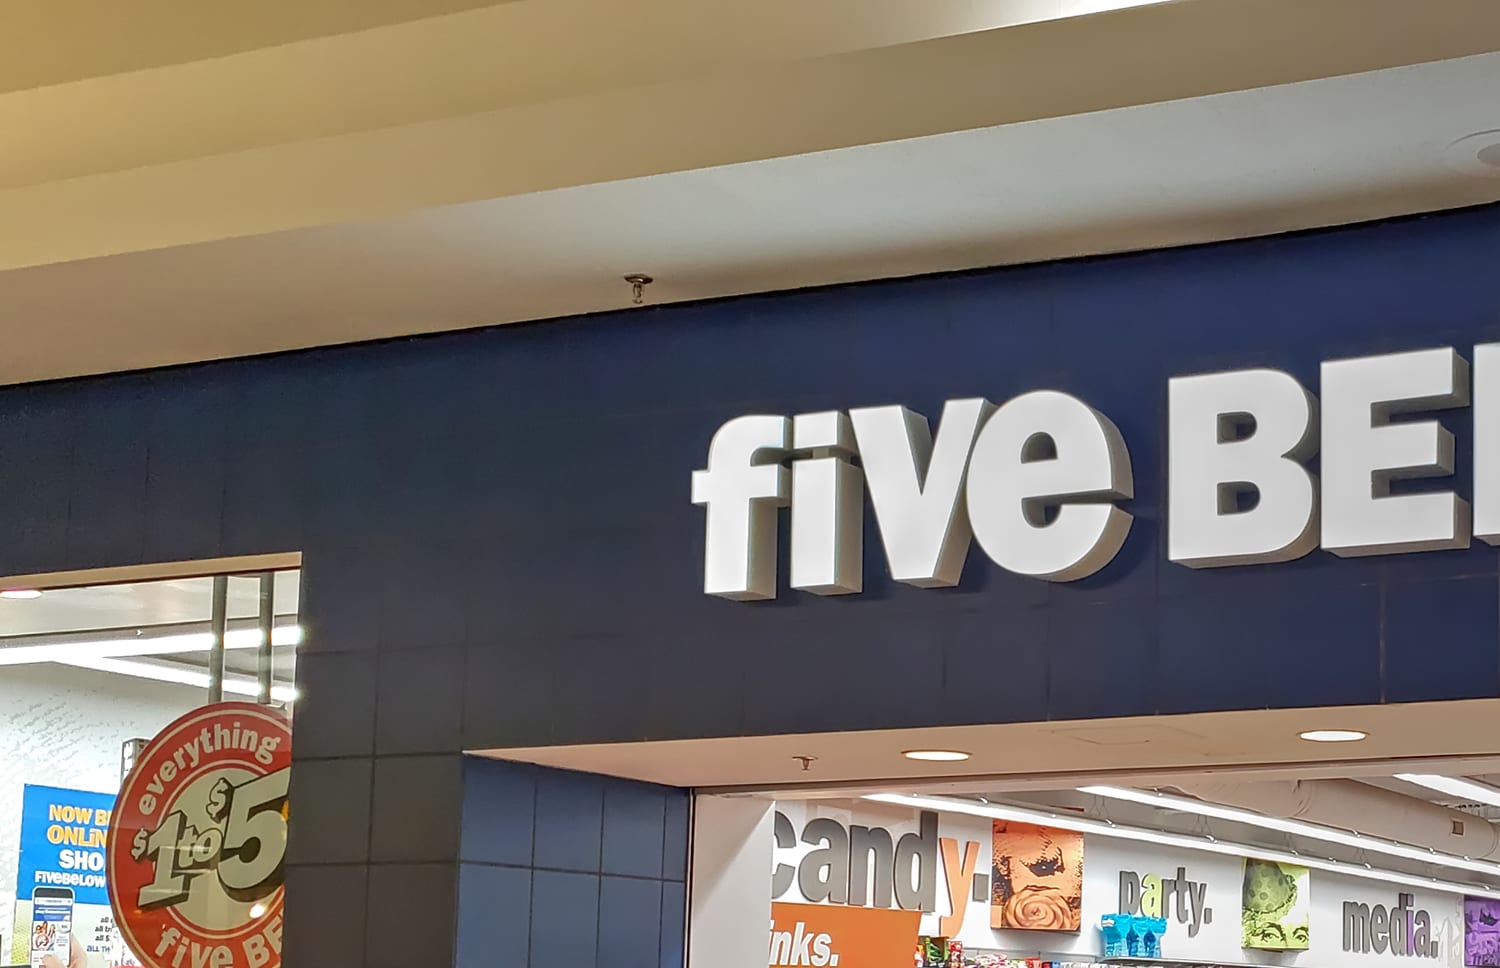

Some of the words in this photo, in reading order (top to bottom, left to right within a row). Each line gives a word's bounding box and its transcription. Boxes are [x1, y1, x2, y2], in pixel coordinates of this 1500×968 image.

[690, 388, 1133, 602] five
[138, 721, 282, 816] everything
[48, 803, 92, 825] NOW
[178, 823, 224, 869] to
[769, 810, 990, 940] candy.
[1118, 866, 1213, 938] party.
[1342, 892, 1439, 960] media.
